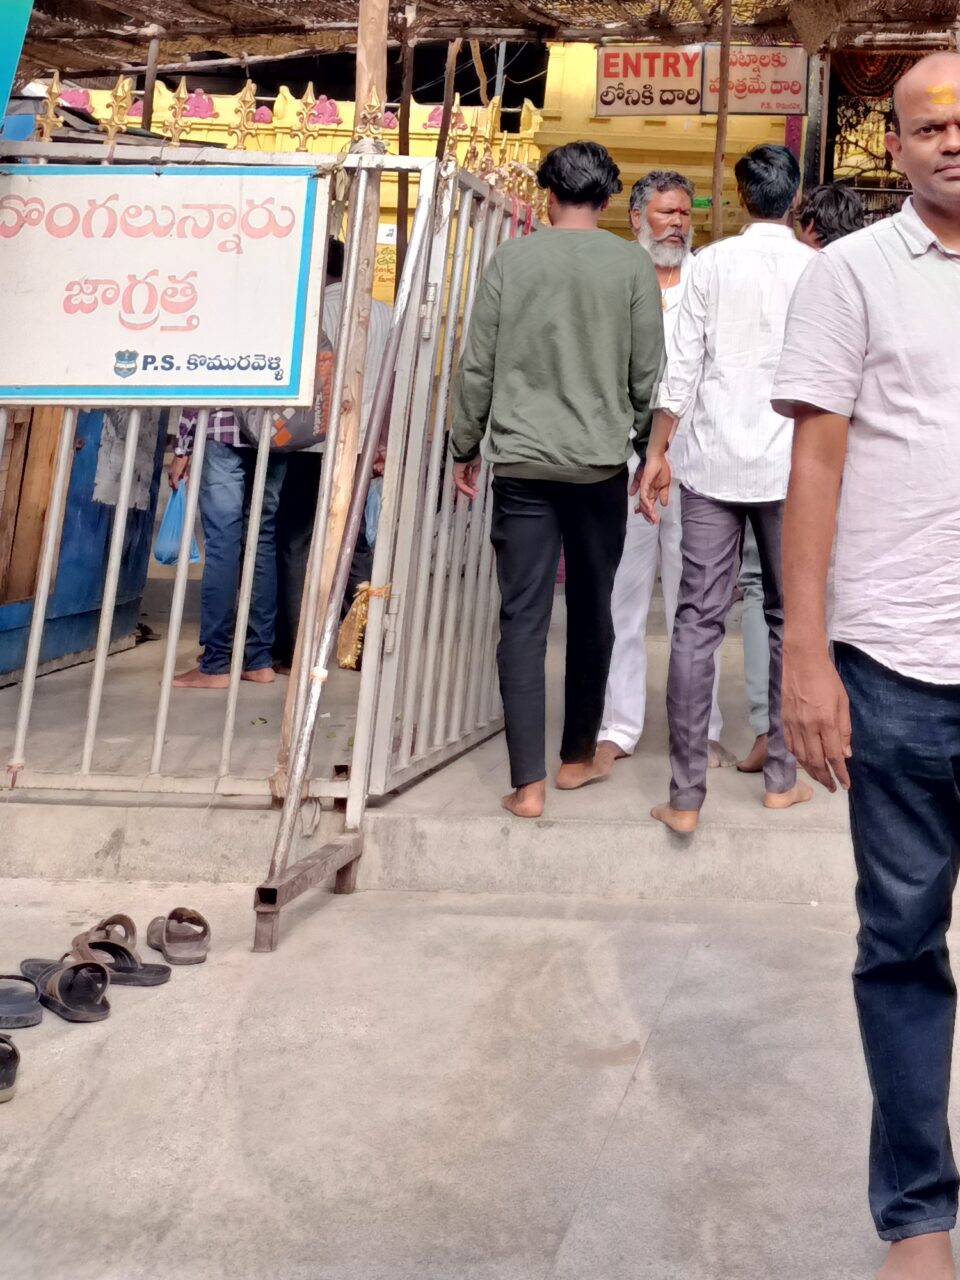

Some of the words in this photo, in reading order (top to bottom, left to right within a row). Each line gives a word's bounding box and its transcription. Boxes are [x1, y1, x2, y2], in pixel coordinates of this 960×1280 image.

[603, 52, 700, 78] ENTRY
[600, 82, 654, 106] లోనికి
[660, 88, 700, 105] దారి
[770, 80, 802, 95] దారి
[62, 269, 200, 332] జాగ్రత్త
[142, 355, 181, 370] P.S.
